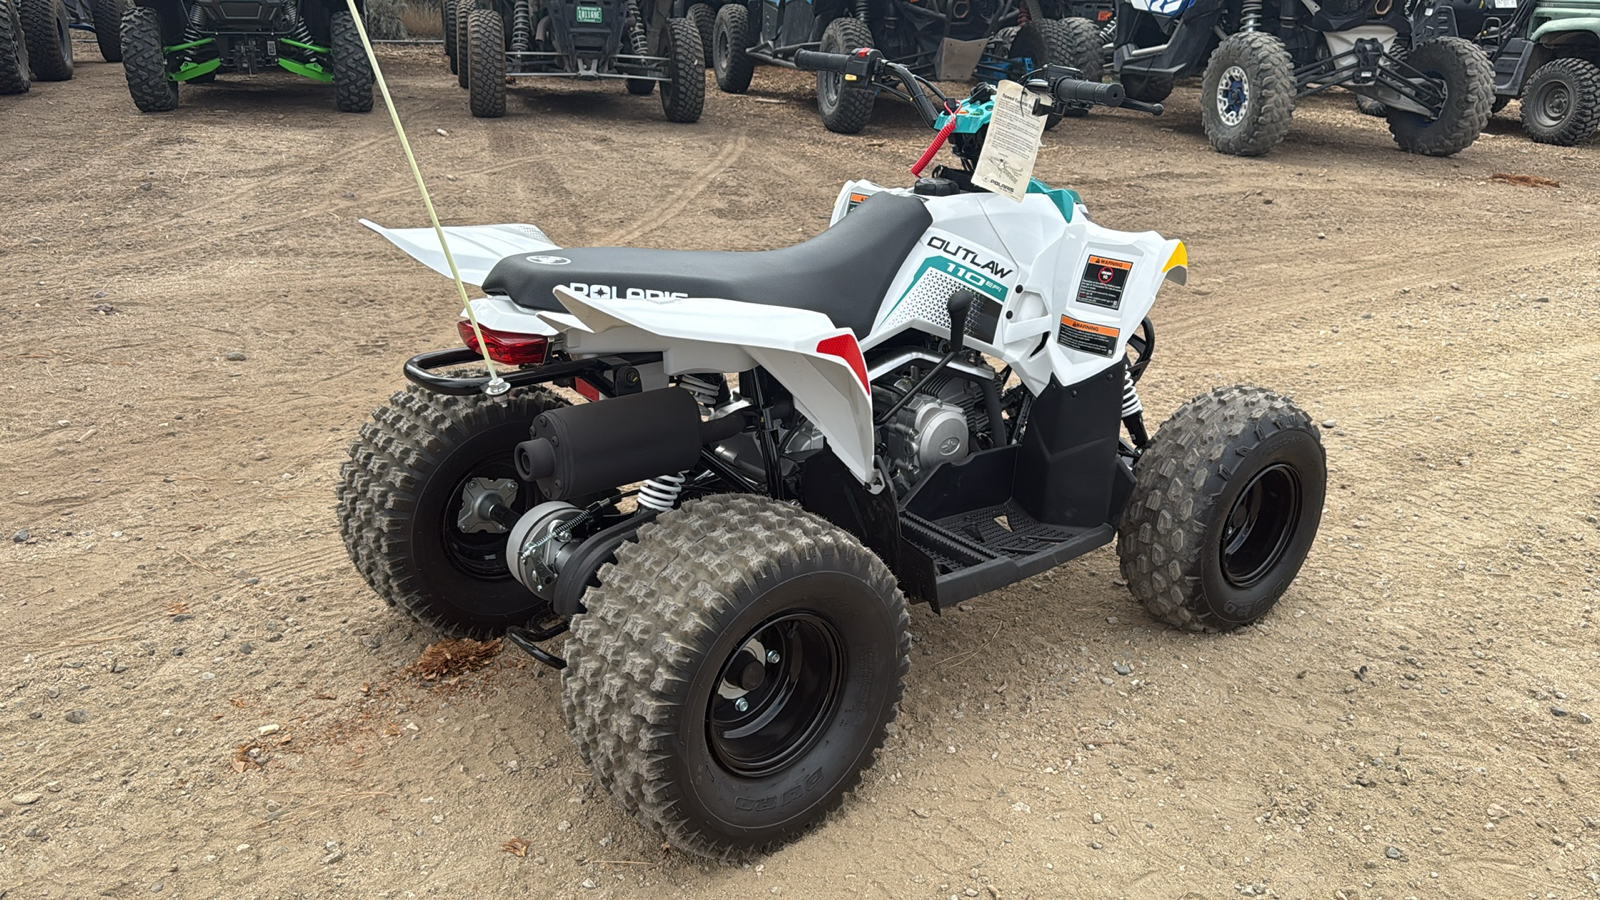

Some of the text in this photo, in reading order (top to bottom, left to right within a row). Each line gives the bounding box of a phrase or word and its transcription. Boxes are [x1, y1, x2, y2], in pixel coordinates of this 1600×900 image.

[1002, 93, 1015, 101] Speed
[990, 179, 1015, 193] POLARIS
[926, 236, 1013, 279] OUTLAW
[1101, 259, 1123, 268] WARNING
[945, 262, 986, 287] 110
[1076, 322, 1099, 332] WARNING
